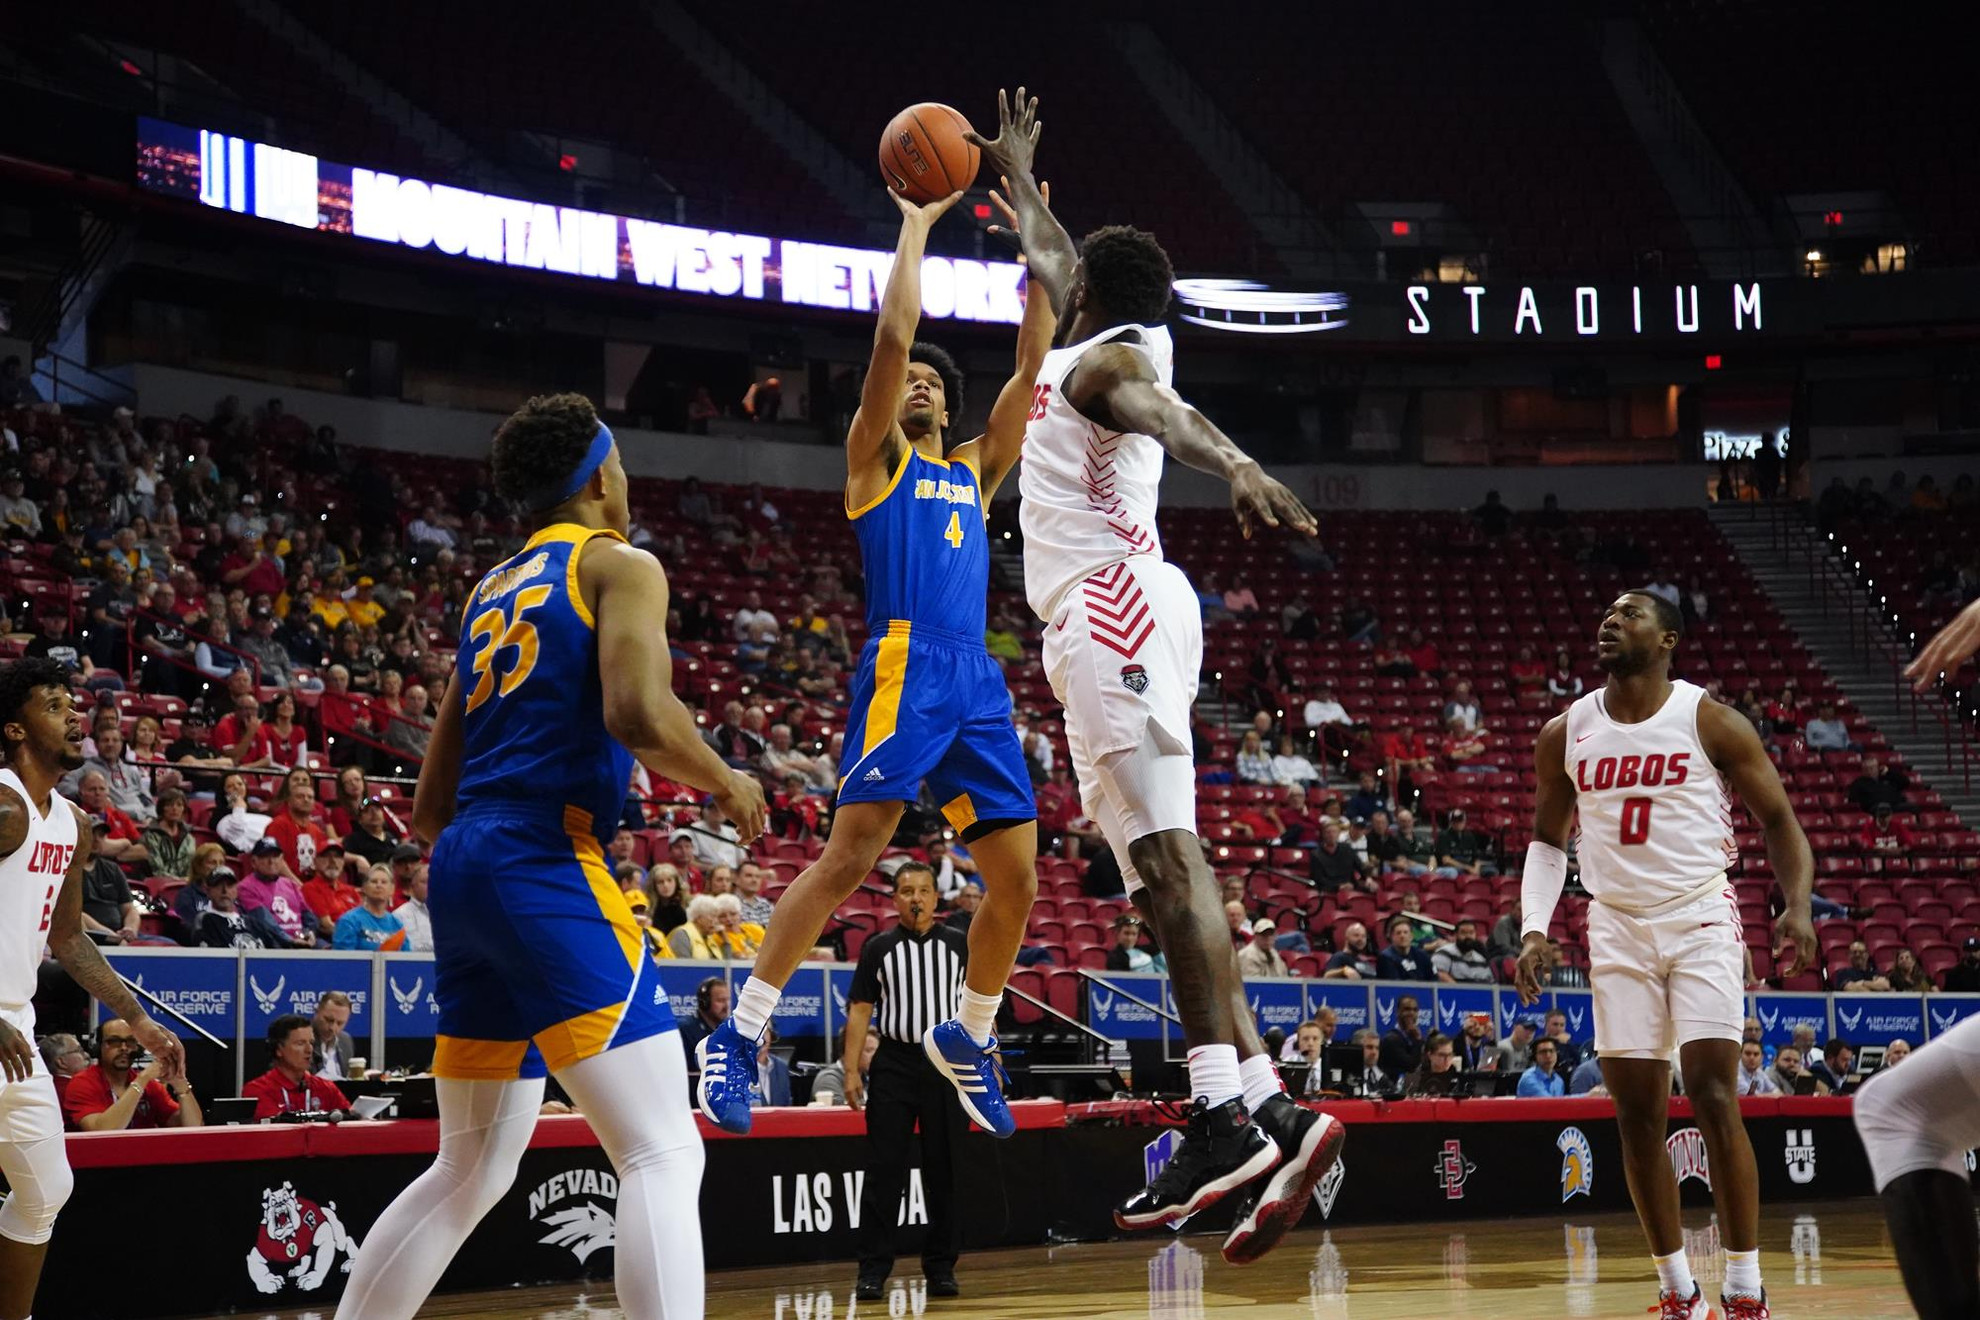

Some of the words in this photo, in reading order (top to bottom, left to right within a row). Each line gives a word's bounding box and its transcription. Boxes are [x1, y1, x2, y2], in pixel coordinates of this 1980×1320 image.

[352, 167, 618, 280] MOUNTAIN
[626, 218, 771, 299] WEST
[1406, 282, 1762, 335] STADIUM
[944, 511, 964, 548] 4
[465, 583, 554, 716] 35
[1577, 752, 1691, 792] LOBOS
[1620, 797, 1653, 845] 0
[150, 991, 176, 1003] AIR
[179, 991, 231, 1003] FORCE
[289, 991, 317, 1003] AIR
[785, 996, 821, 1007] FORCE
[1865, 1016, 1885, 1025] AIR
[1885, 1016, 1919, 1026] FORCE
[1869, 1024, 1917, 1032] RESERVE
[1785, 1146, 1816, 1165] STATE
[528, 1168, 618, 1220] NEVAD
[772, 1172, 833, 1234] LAS
